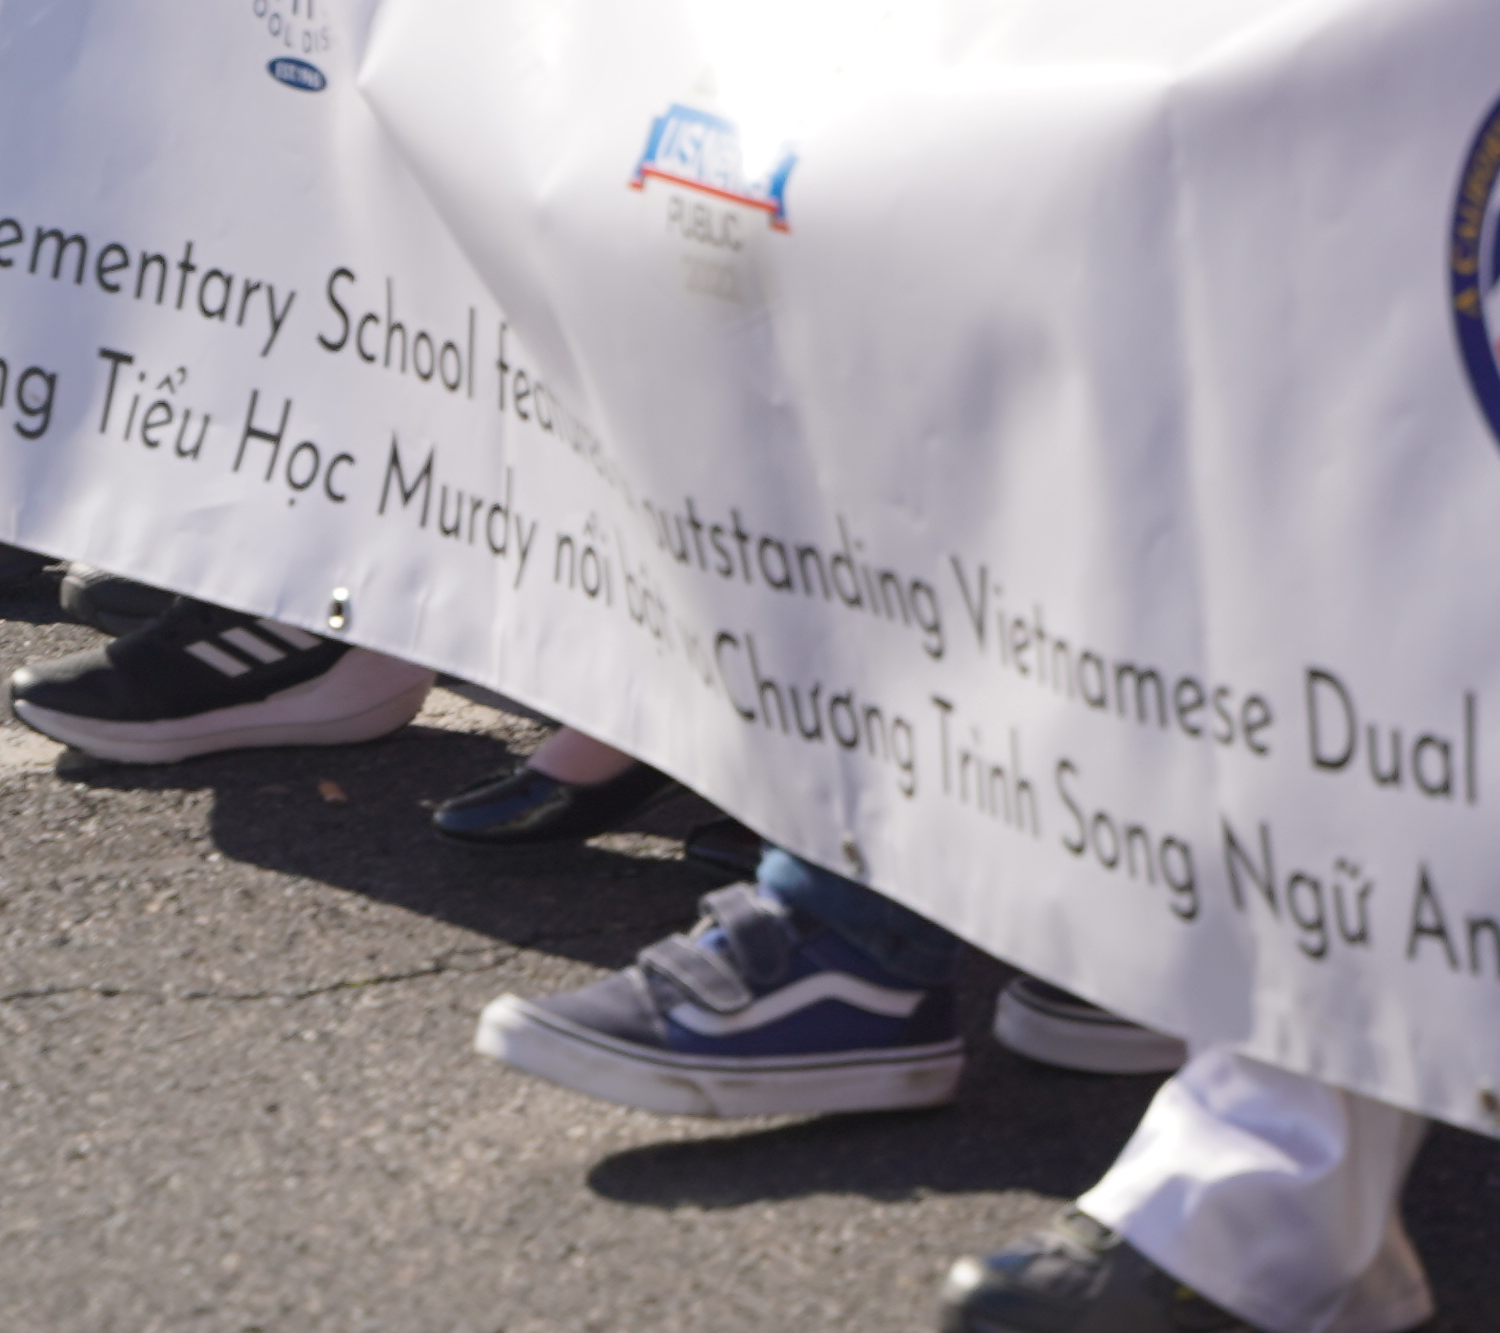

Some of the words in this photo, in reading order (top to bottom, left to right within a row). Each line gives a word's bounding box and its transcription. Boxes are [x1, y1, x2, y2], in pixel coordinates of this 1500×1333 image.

[230, 389, 358, 508] Học
[377, 429, 540, 590] Murdy
[1054, 757, 1202, 922] Song
[316, 267, 477, 400] School
[949, 553, 1274, 755] Vietnamese
[1304, 664, 1480, 805] Dual
